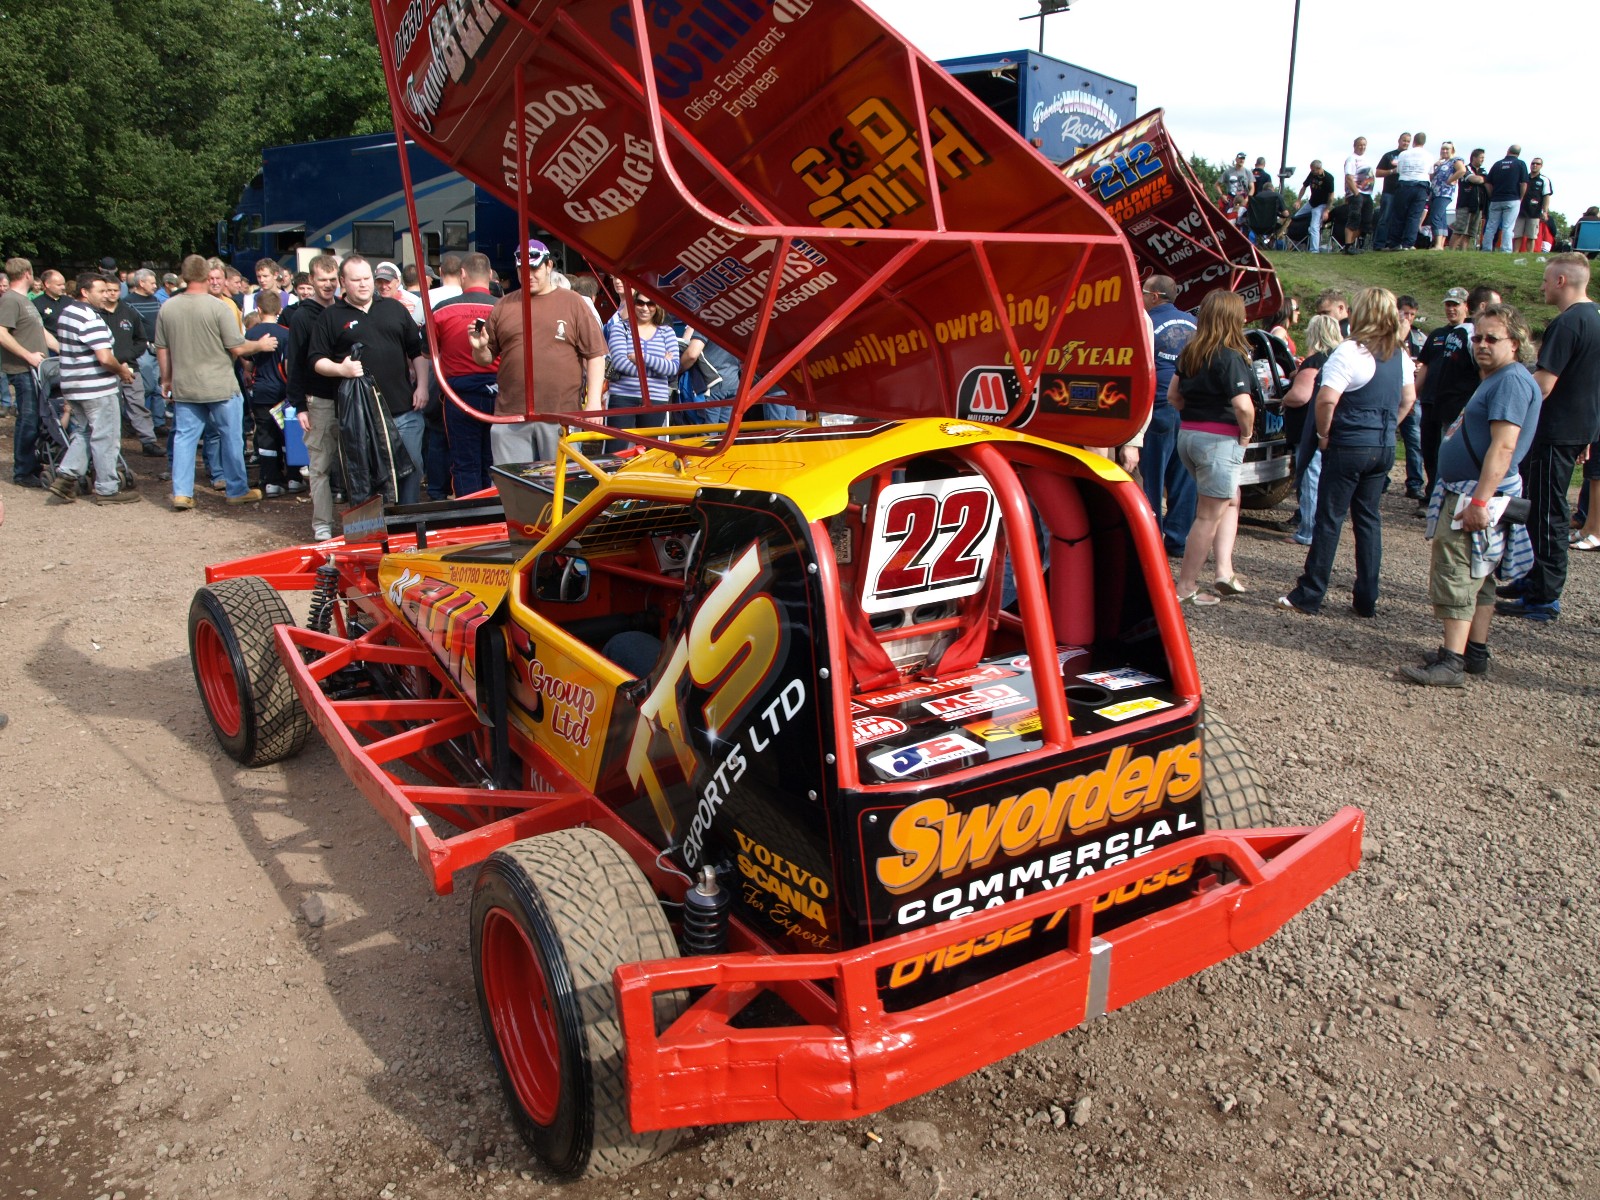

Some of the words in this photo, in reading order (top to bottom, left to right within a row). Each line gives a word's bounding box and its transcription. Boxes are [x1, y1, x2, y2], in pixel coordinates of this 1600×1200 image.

[683, 87, 723, 121] Office
[713, 26, 786, 91] Equipment
[721, 65, 780, 118] Engineer
[543, 124, 610, 196] ROAD
[563, 132, 654, 223] GARAGE
[1090, 141, 1164, 201] 212
[1105, 174, 1168, 216] BALDWIN
[1146, 203, 1203, 256] Trave
[1164, 246, 1193, 266] LONG
[671, 256, 754, 312] DRIVER
[774, 271, 838, 314] 655000
[874, 487, 995, 597] 22
[528, 658, 595, 723] Group
[928, 686, 1010, 713] MSD
[551, 704, 592, 748] Ltd
[682, 743, 748, 869] EXPORTS
[752, 678, 807, 754] LTD
[876, 738, 1202, 892] Sworders
[733, 829, 830, 899] VOLVO
[737, 853, 828, 930] SCANIA
[898, 813, 1197, 926] COMMERCIAL
[769, 903, 830, 947] Export
